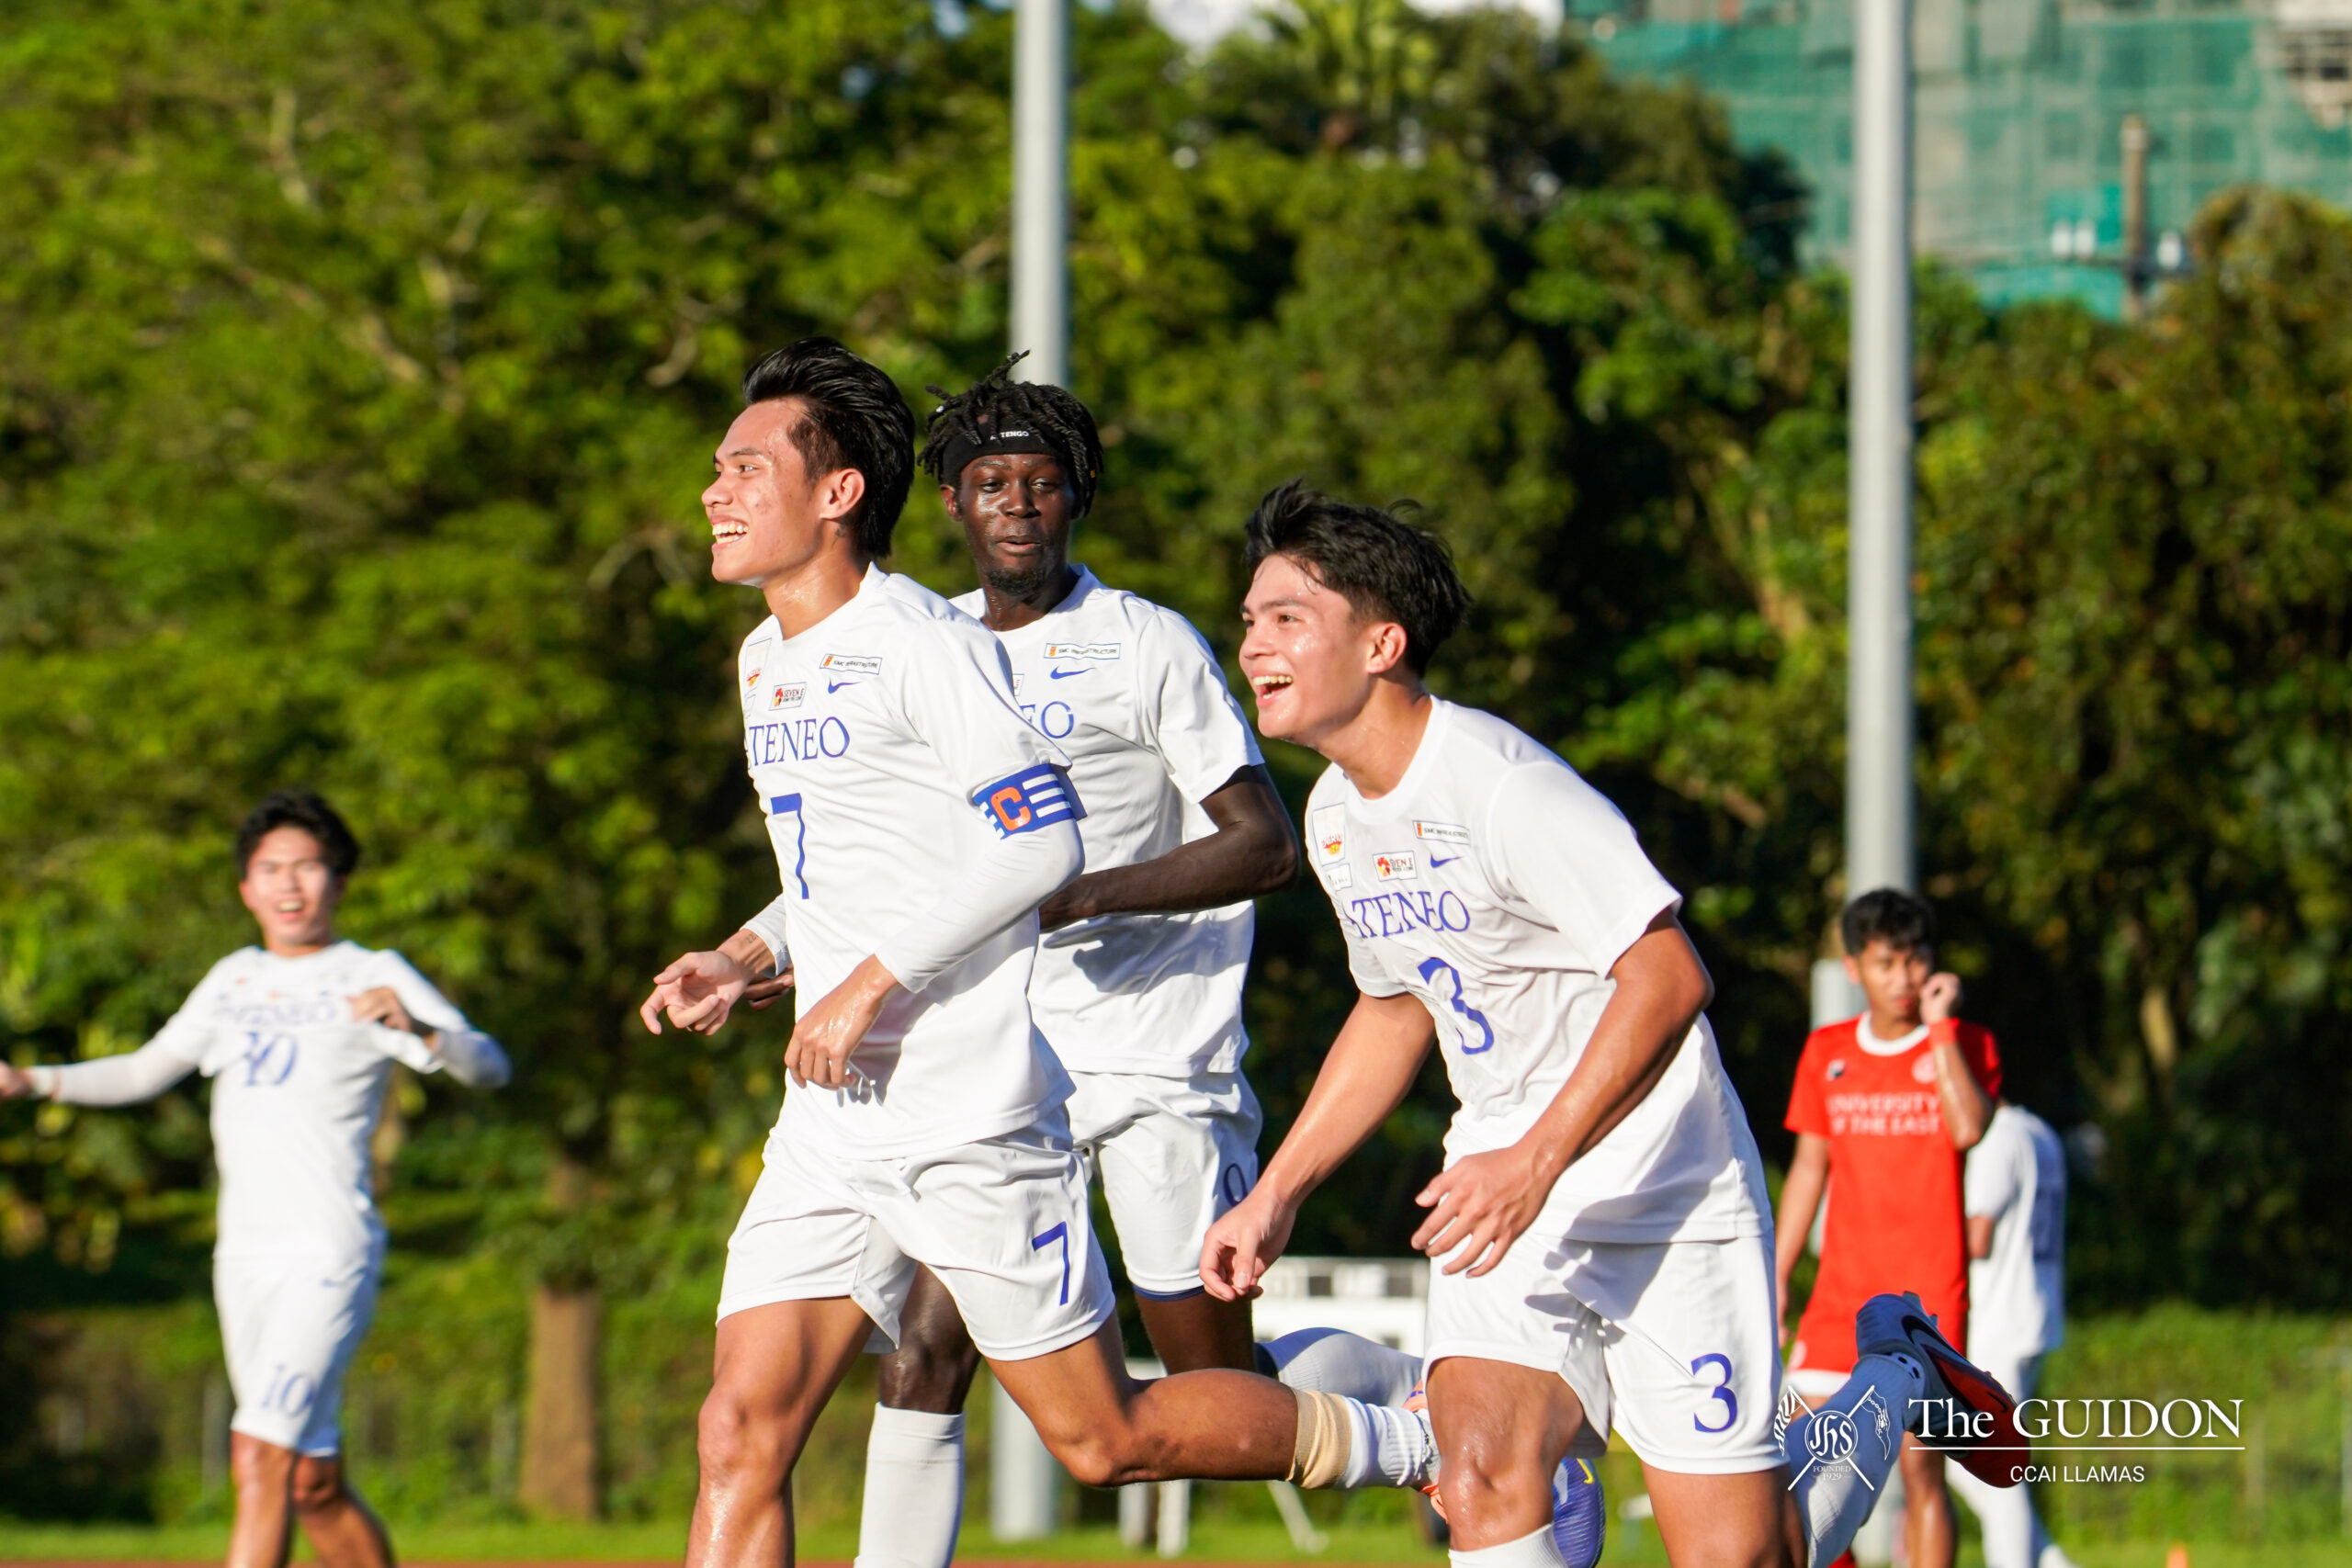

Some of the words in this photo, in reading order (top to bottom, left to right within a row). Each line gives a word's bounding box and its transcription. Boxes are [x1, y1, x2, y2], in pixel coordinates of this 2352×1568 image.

[744, 716, 850, 770] TENEO
[990, 786, 1032, 831] C
[770, 793, 809, 900] 7
[1418, 957, 1494, 1055] 3
[243, 1031, 298, 1087] 10
[1850, 1115, 1885, 1135] THE
[1891, 1114, 1939, 1135] EAST
[1032, 1221, 1069, 1306] 7
[1691, 1352, 1737, 1433] 3
